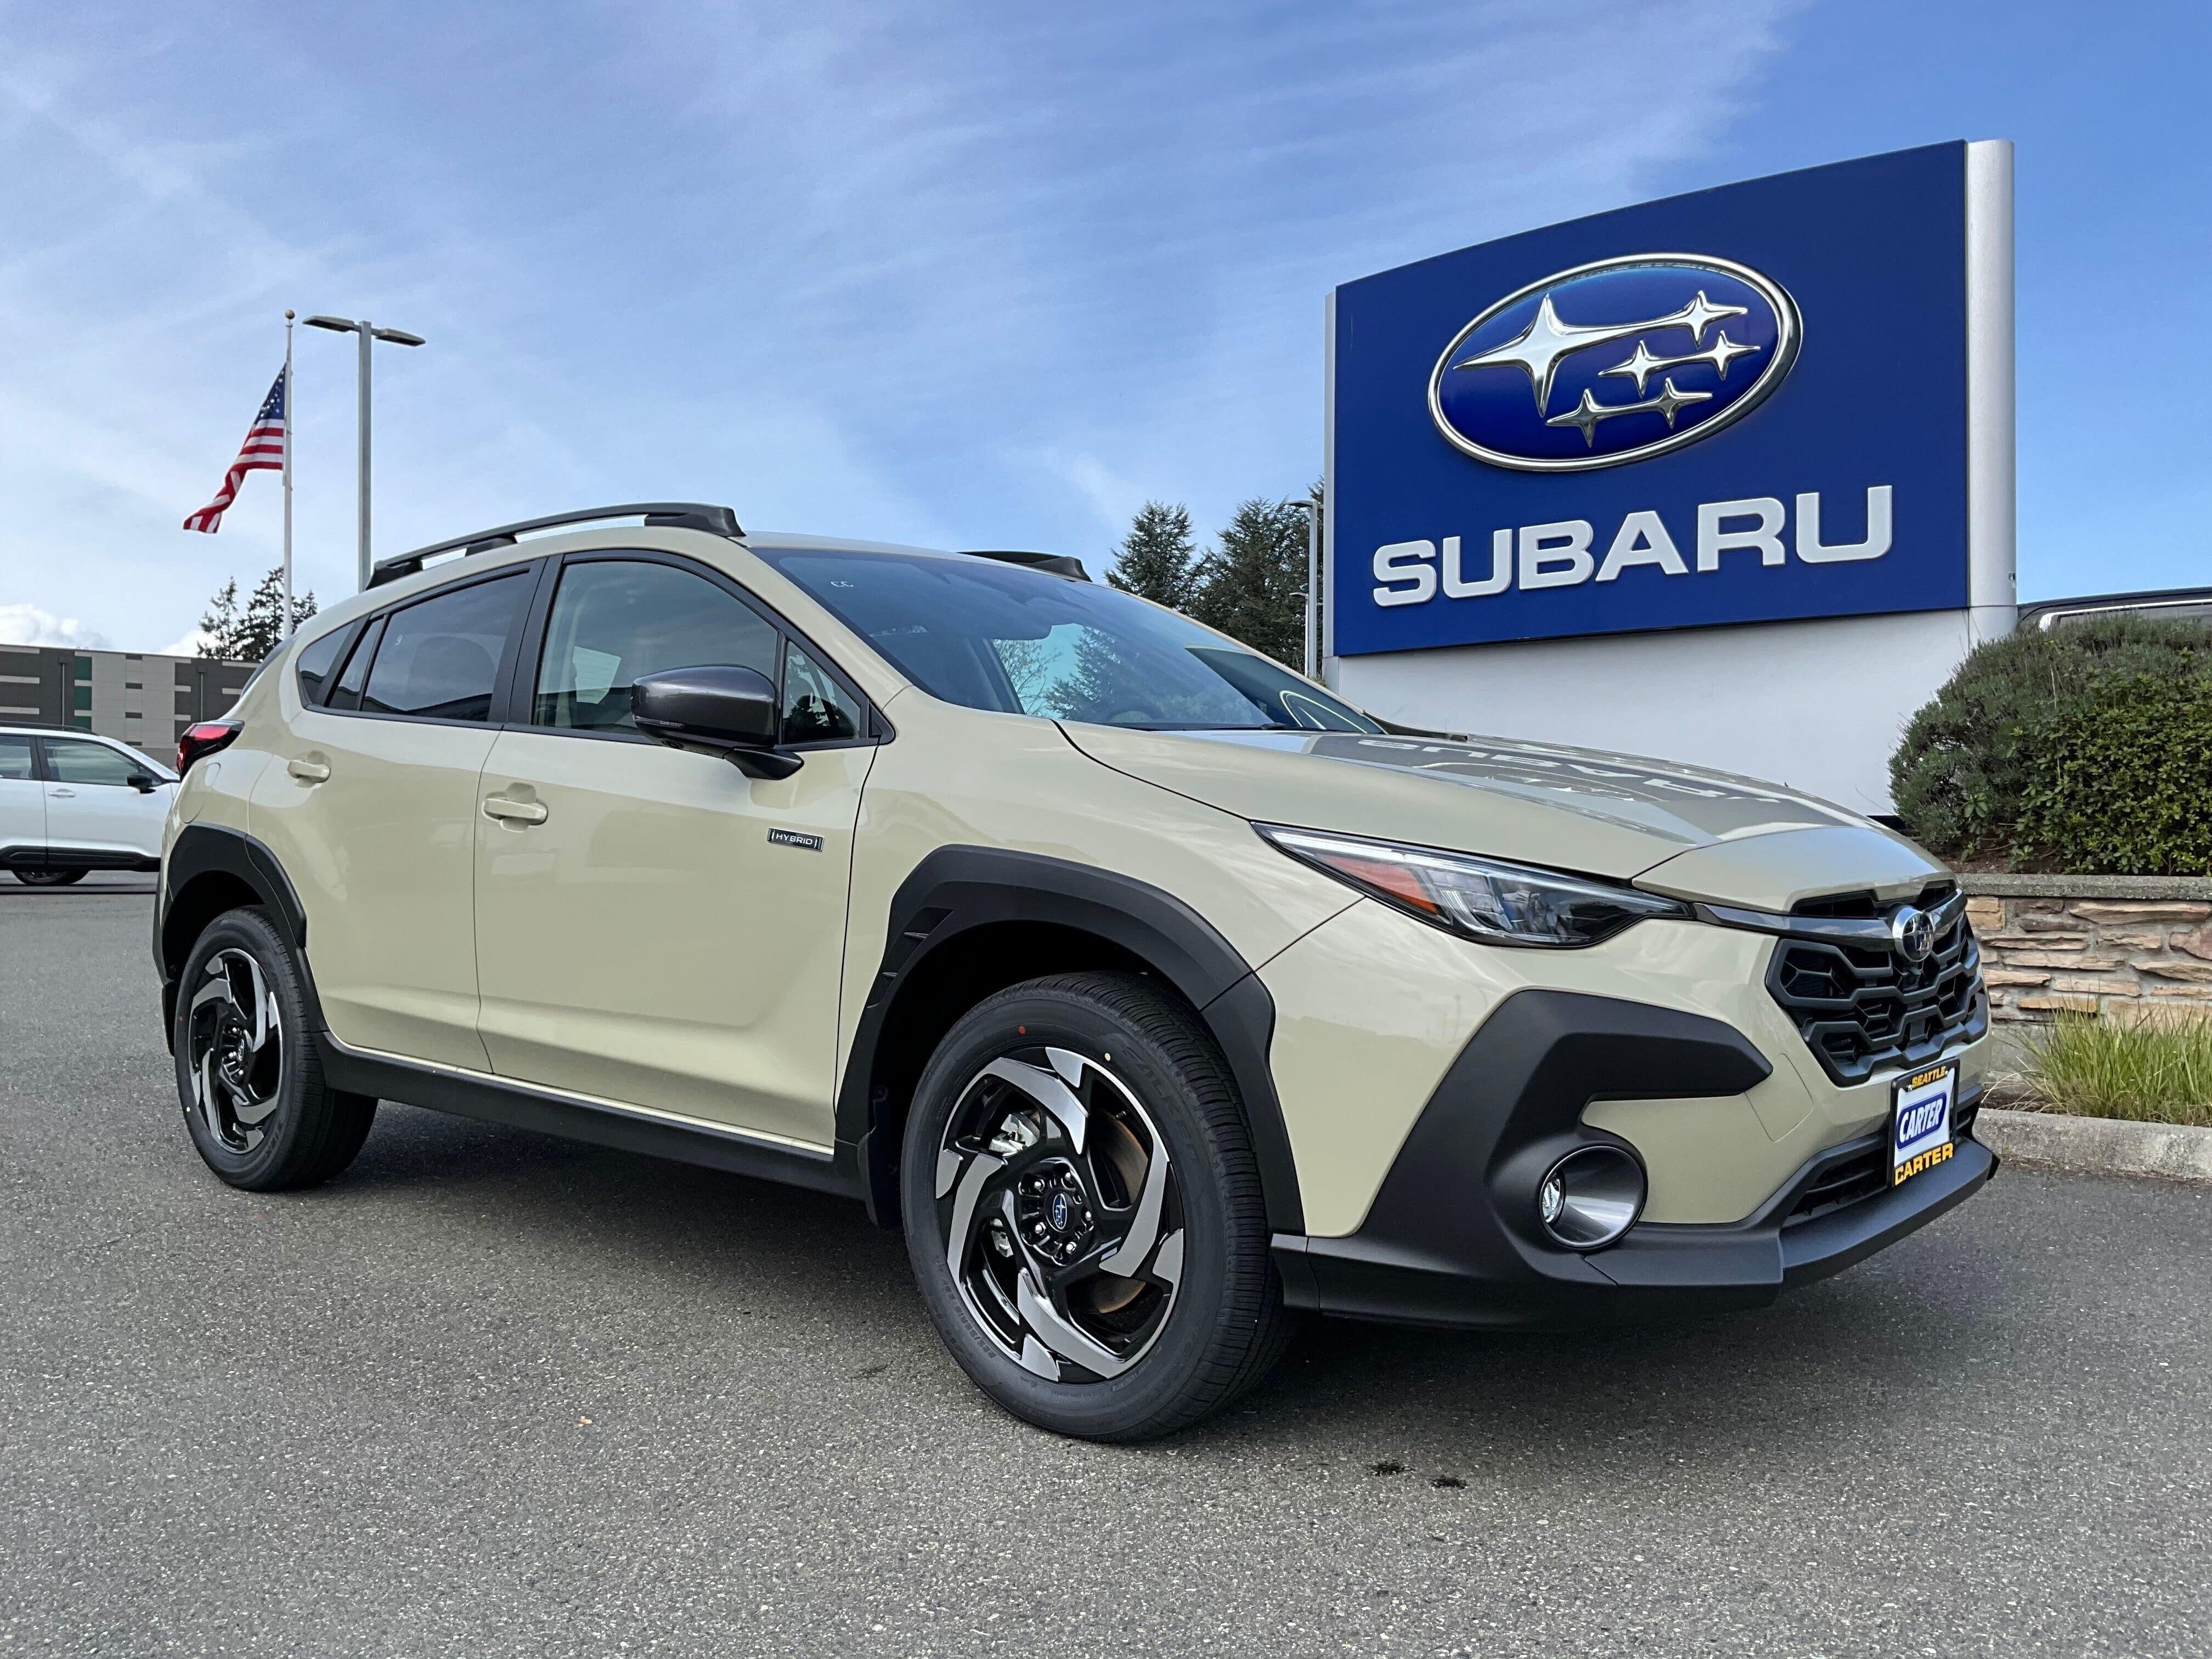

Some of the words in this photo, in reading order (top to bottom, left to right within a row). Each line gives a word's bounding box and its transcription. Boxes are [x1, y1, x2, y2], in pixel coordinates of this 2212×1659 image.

[1373, 484, 1893, 607] SUBARU
[776, 833, 813, 845] HYBRID
[1911, 1065, 1946, 1088] SEATTLE
[1899, 1098, 1943, 1143] CARTER
[1894, 1143, 1954, 1186] CARTER
